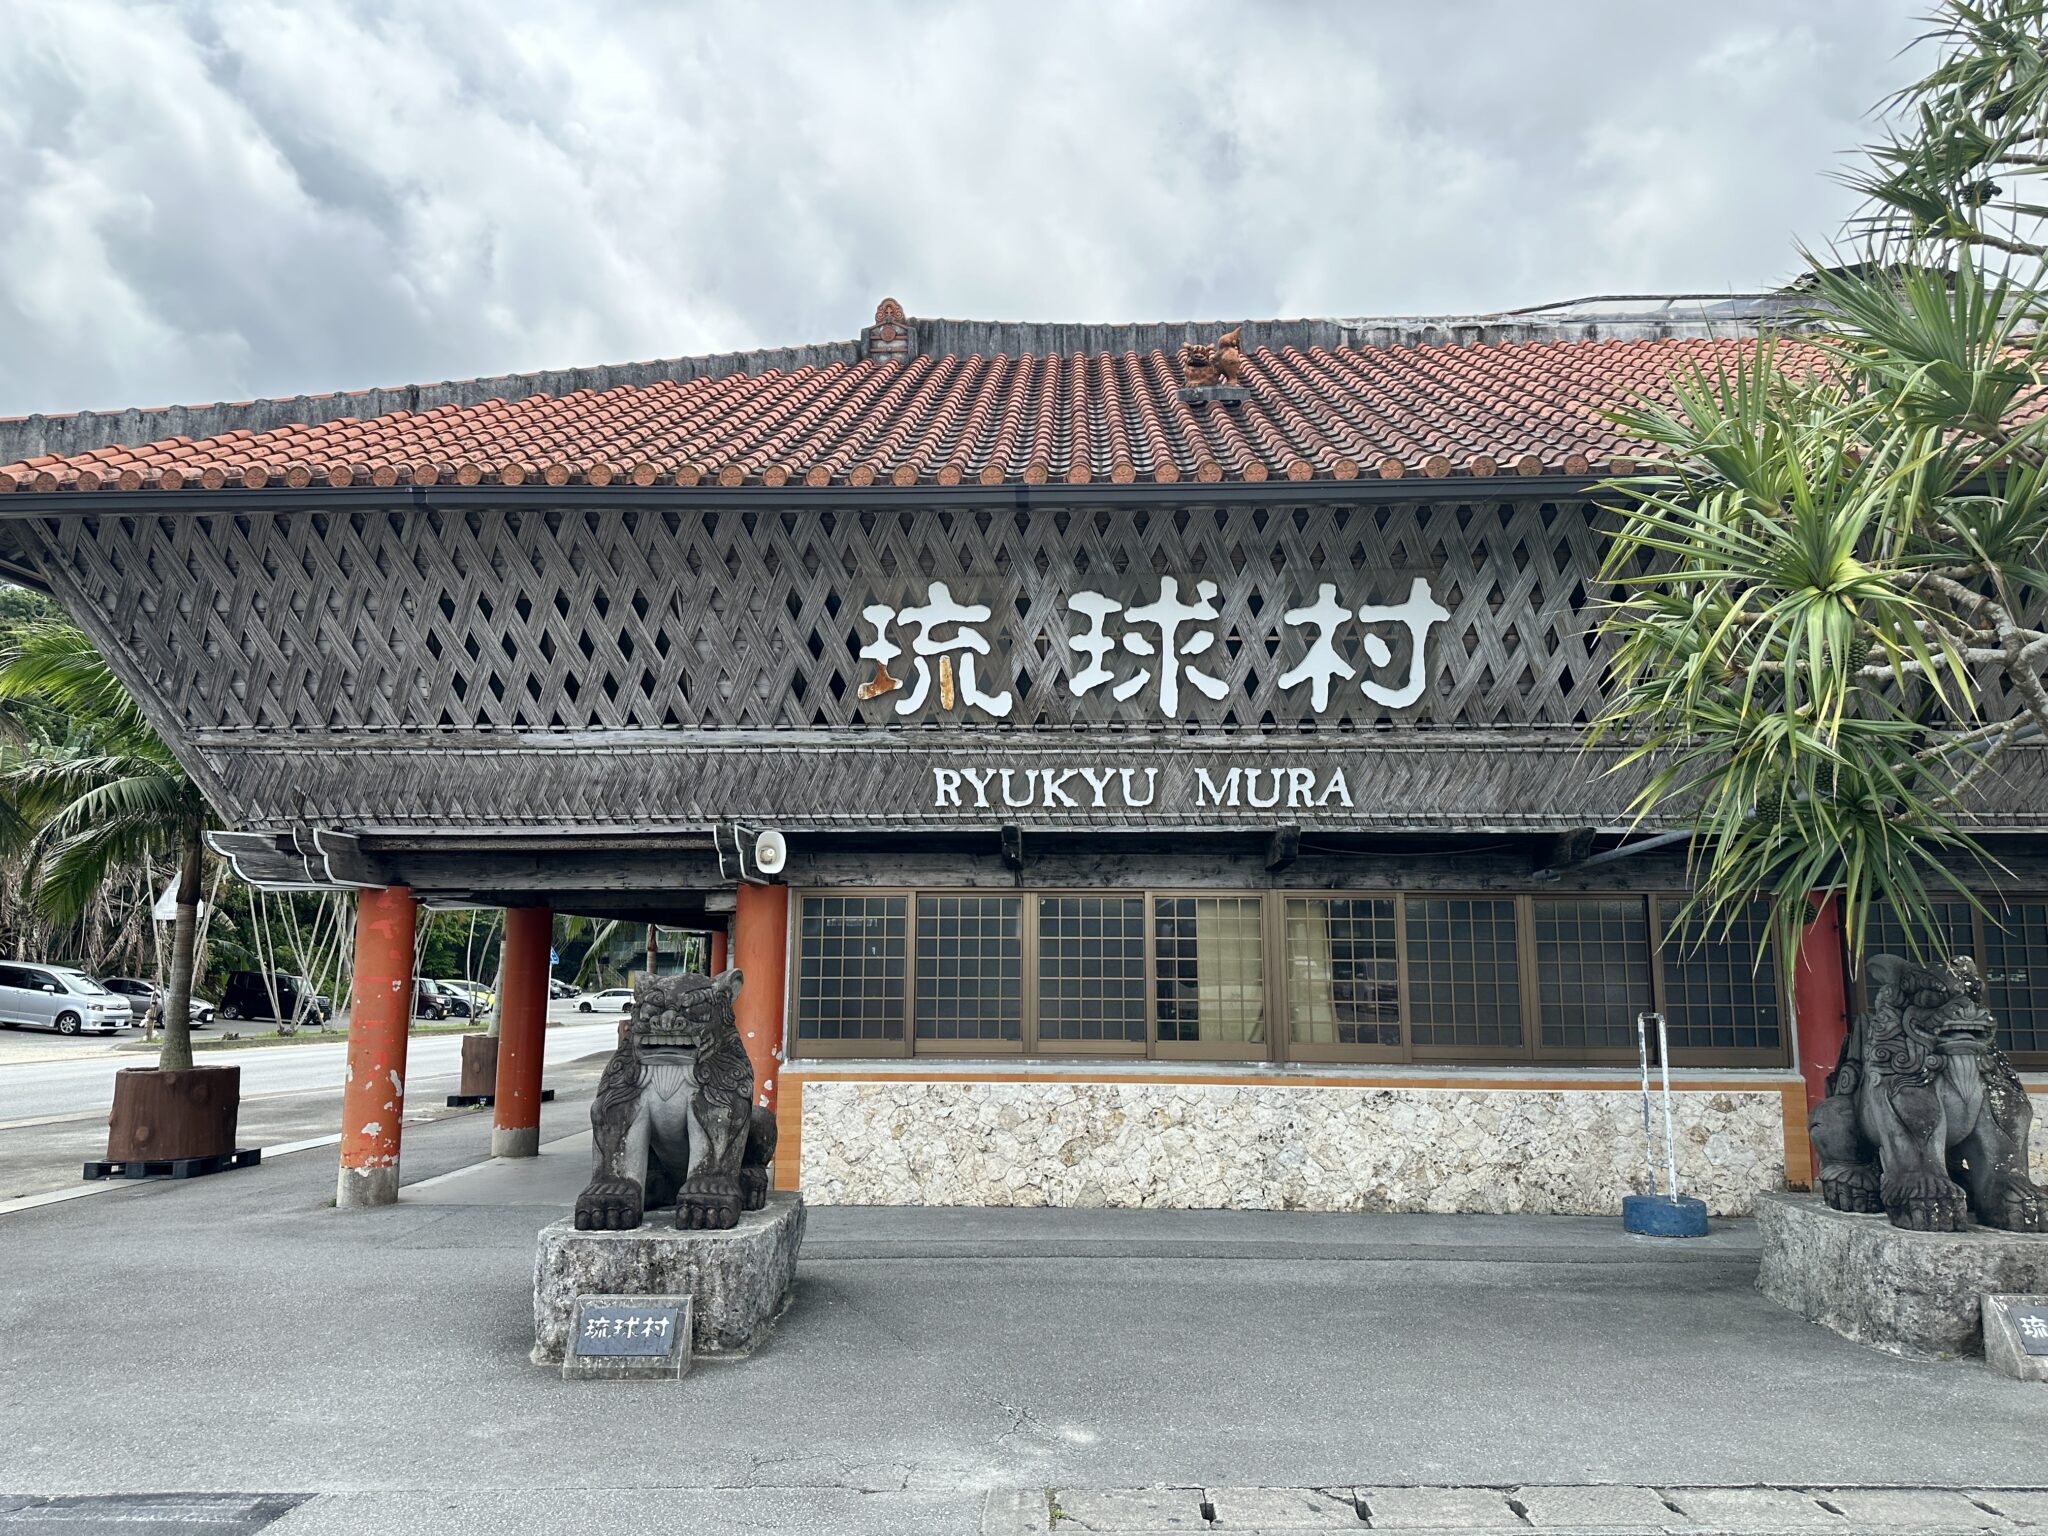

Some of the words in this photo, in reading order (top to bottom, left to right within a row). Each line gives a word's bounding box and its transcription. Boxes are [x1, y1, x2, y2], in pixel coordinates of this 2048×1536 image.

[858, 576, 1451, 718] 琉球村
[932, 767, 1159, 808] RYUKYU
[1194, 766, 1356, 808] MURA
[584, 1315, 670, 1340] 琉球村
